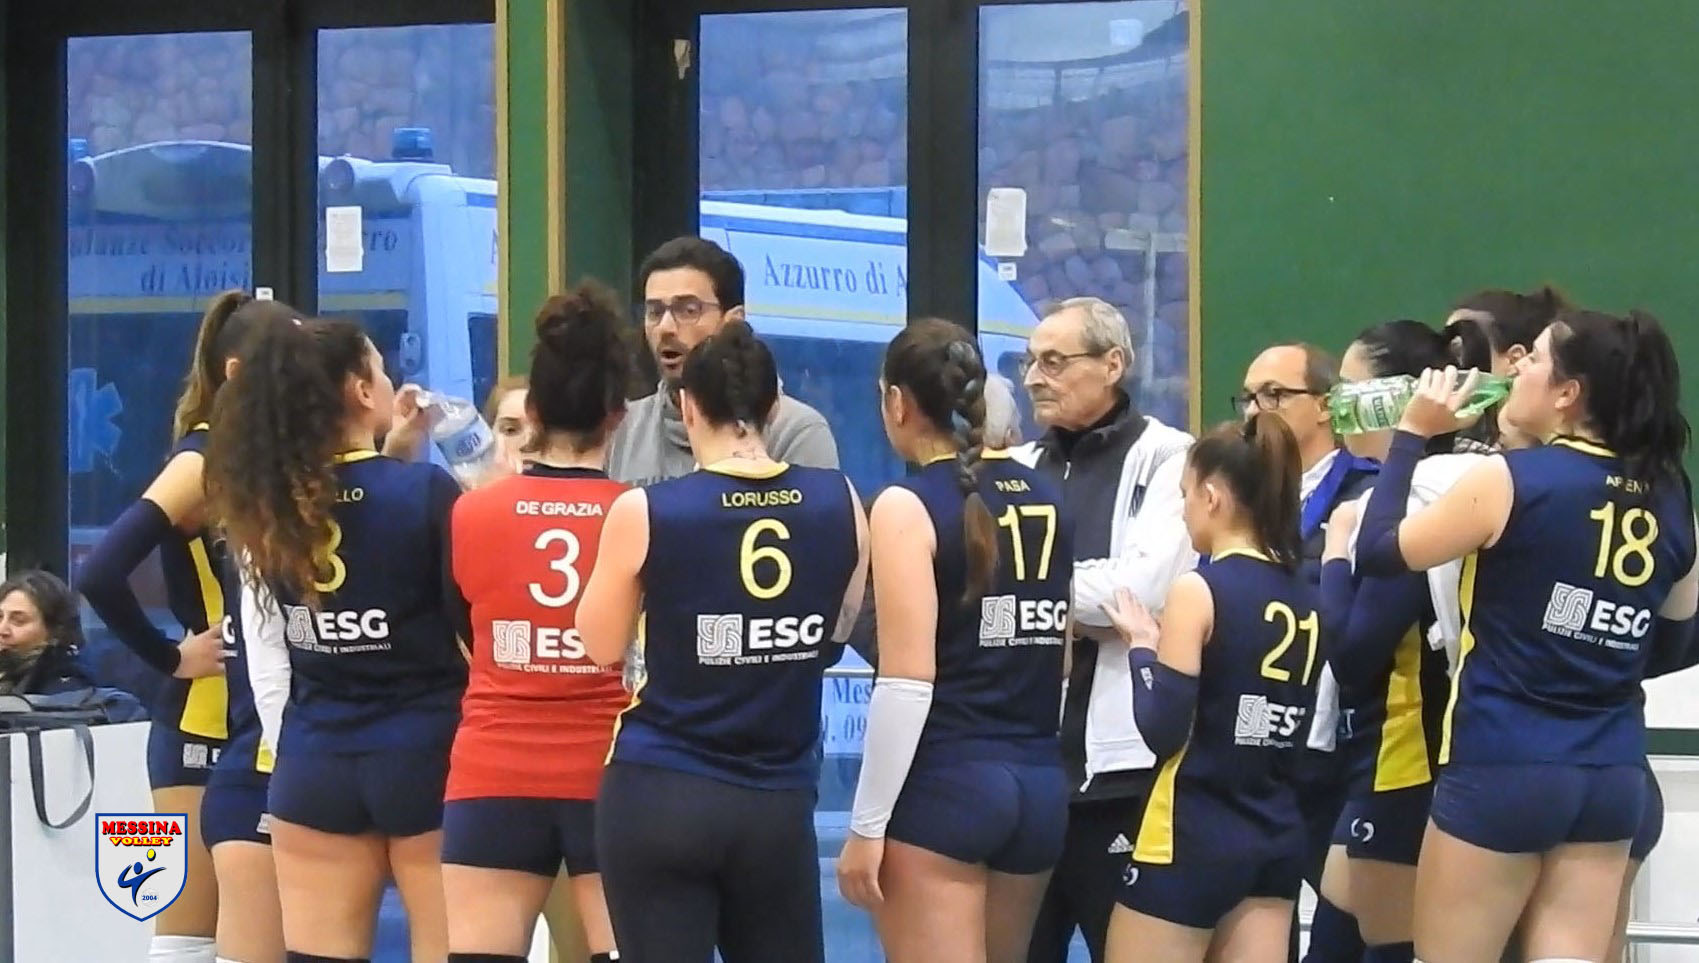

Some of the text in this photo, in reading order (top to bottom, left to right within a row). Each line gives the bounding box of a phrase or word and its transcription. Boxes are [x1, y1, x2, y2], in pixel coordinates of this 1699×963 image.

[141, 262, 164, 293] di
[764, 252, 857, 294] Azzurro
[866, 260, 888, 295] di
[721, 488, 803, 508] LORUSSO
[995, 479, 1031, 493] PASA
[516, 500, 604, 517] DE GRAZIA
[741, 518, 793, 599] 6
[998, 504, 1057, 581] 17
[1589, 500, 1659, 587] 18
[528, 528, 580, 608] 3
[315, 608, 390, 641] ESG
[748, 613, 825, 650] ESG
[1020, 599, 1067, 631] ESG
[1590, 599, 1652, 638] ESG
[536, 626, 586, 660] ES
[1261, 601, 1319, 686] 21
